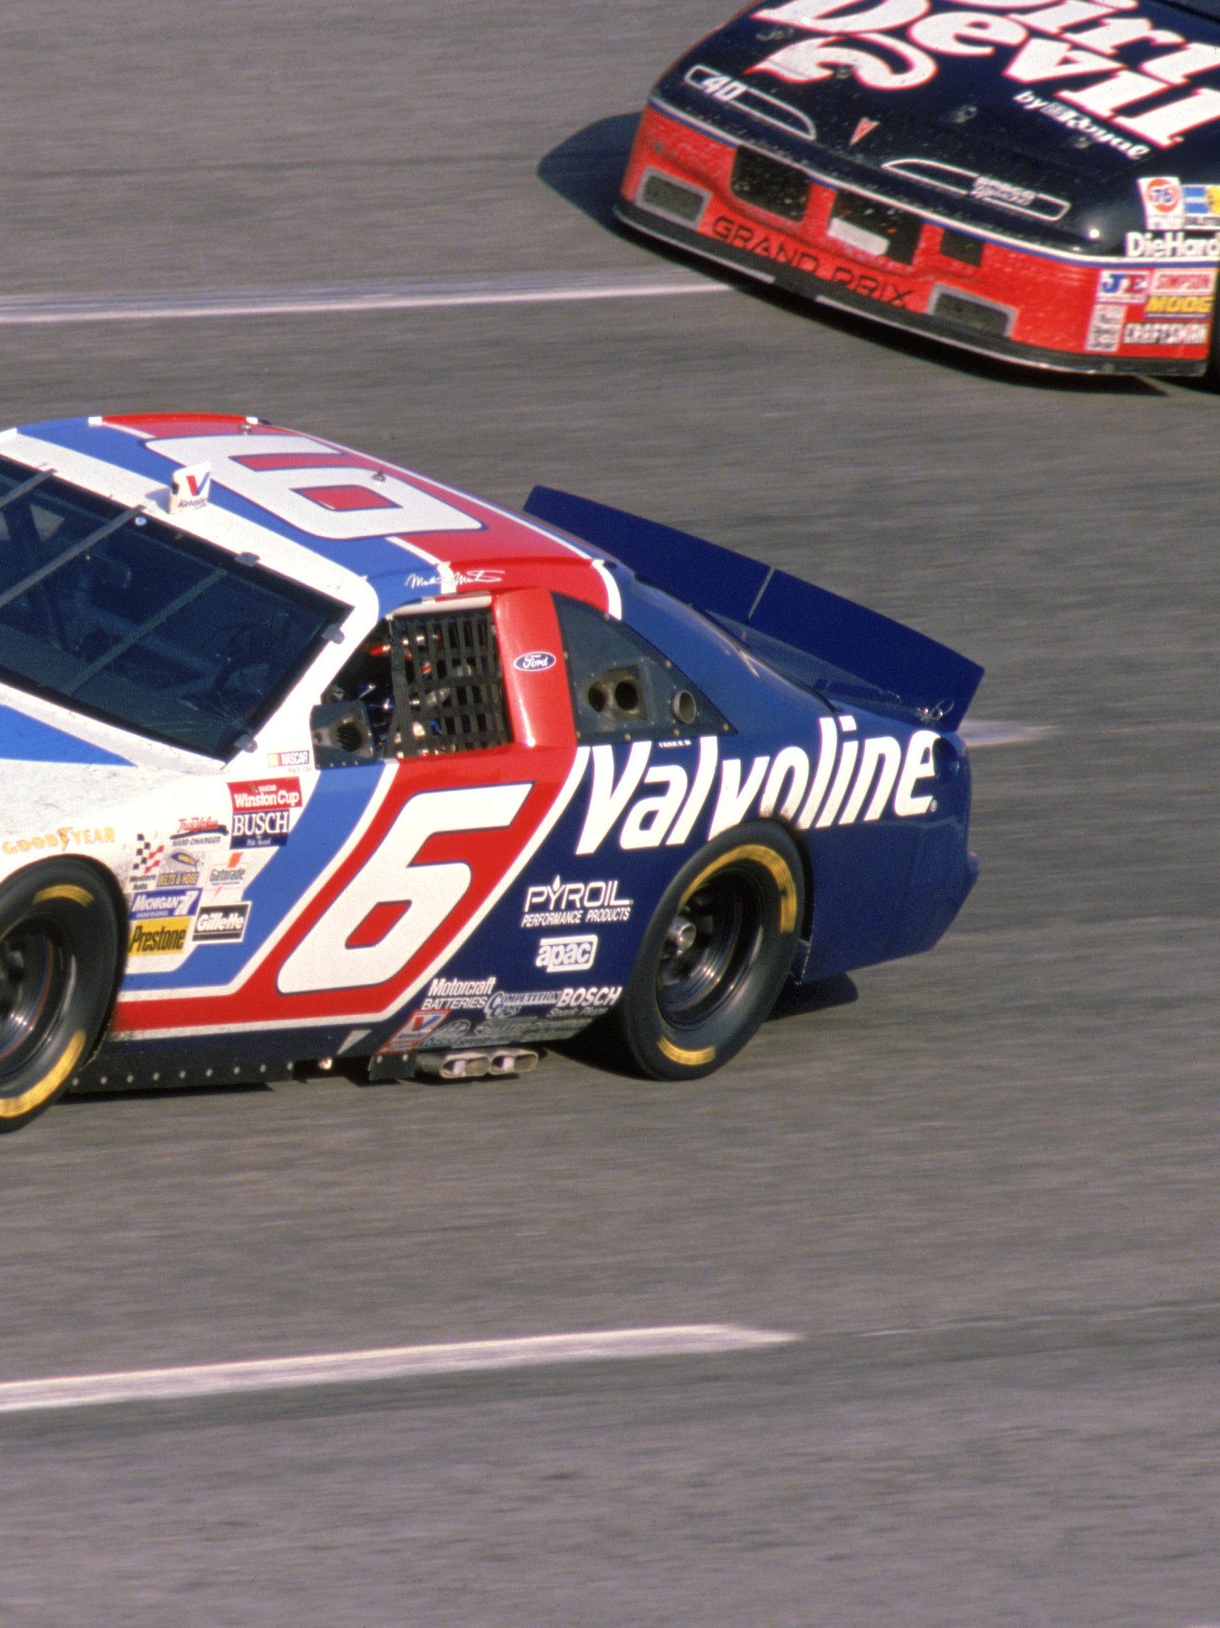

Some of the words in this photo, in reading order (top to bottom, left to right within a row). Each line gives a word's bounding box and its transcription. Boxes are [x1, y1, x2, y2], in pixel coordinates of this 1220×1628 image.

[945, 0, 1220, 86] irt
[700, 76, 748, 101] 40
[1013, 90, 1048, 110] by
[1126, 231, 1220, 258] DieHard
[711, 216, 819, 273] GRAND
[832, 266, 912, 308] PRIX
[1146, 296, 1213, 313] MOOG
[144, 434, 483, 539] 6
[522, 653, 548, 668] Ford
[281, 752, 308, 765] NASCAR
[575, 715, 941, 856] Valvoline
[234, 792, 277, 808] Winston
[278, 789, 300, 806] Cup
[232, 811, 289, 837] BUSCH
[209, 867, 246, 882] Gatorade
[276, 782, 532, 994] 6
[524, 879, 632, 912] PYROIL
[196, 911, 245, 931] Gillette
[521, 910, 583, 928] PERFORMANCE
[585, 907, 631, 923] PRODUCTS
[130, 925, 187, 952] Prestone
[536, 940, 592, 970] apac
[428, 977, 496, 997] Motorcraft
[557, 986, 623, 1008] BOSCH
[421, 997, 488, 1011] BATTERIES
